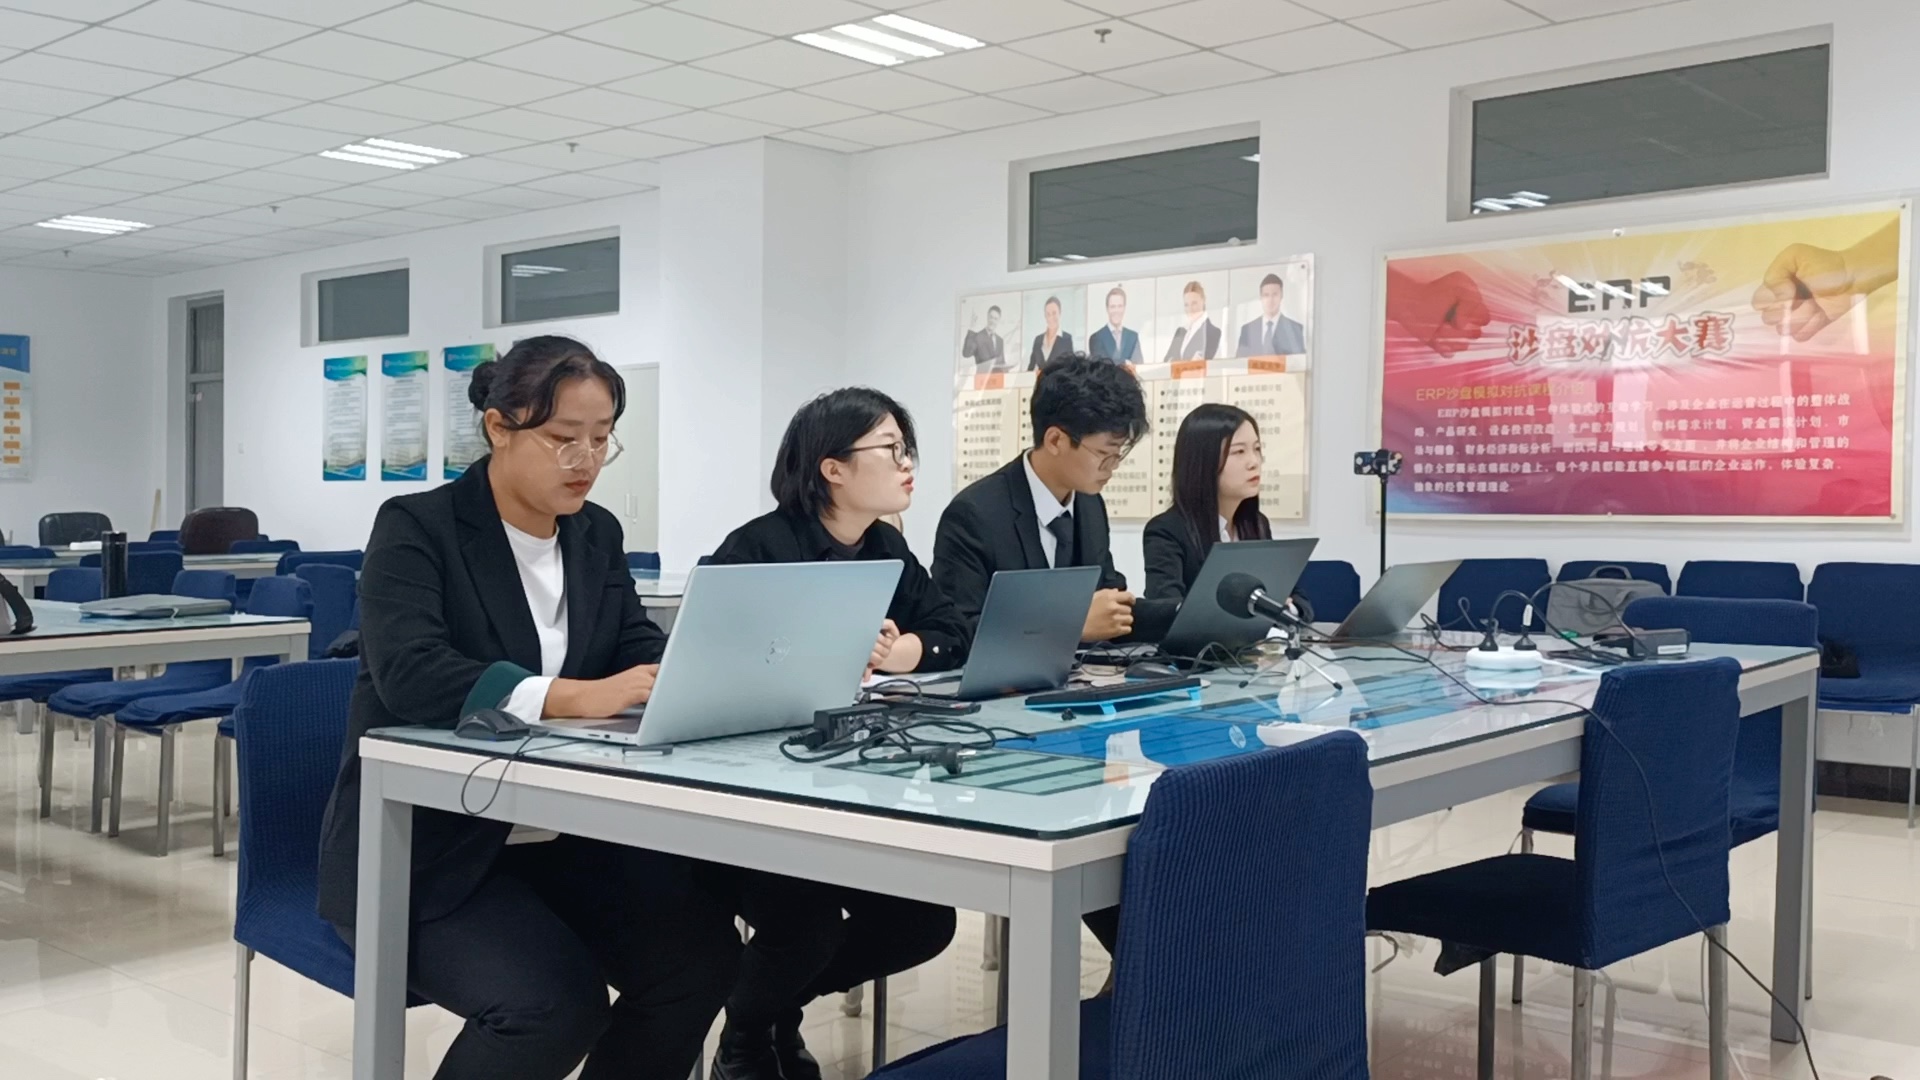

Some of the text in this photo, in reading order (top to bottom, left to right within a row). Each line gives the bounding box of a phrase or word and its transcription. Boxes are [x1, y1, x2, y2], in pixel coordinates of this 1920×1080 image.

[1567, 275, 1672, 313] ERP
[1508, 311, 1734, 365] 沙盘对抗大赛
